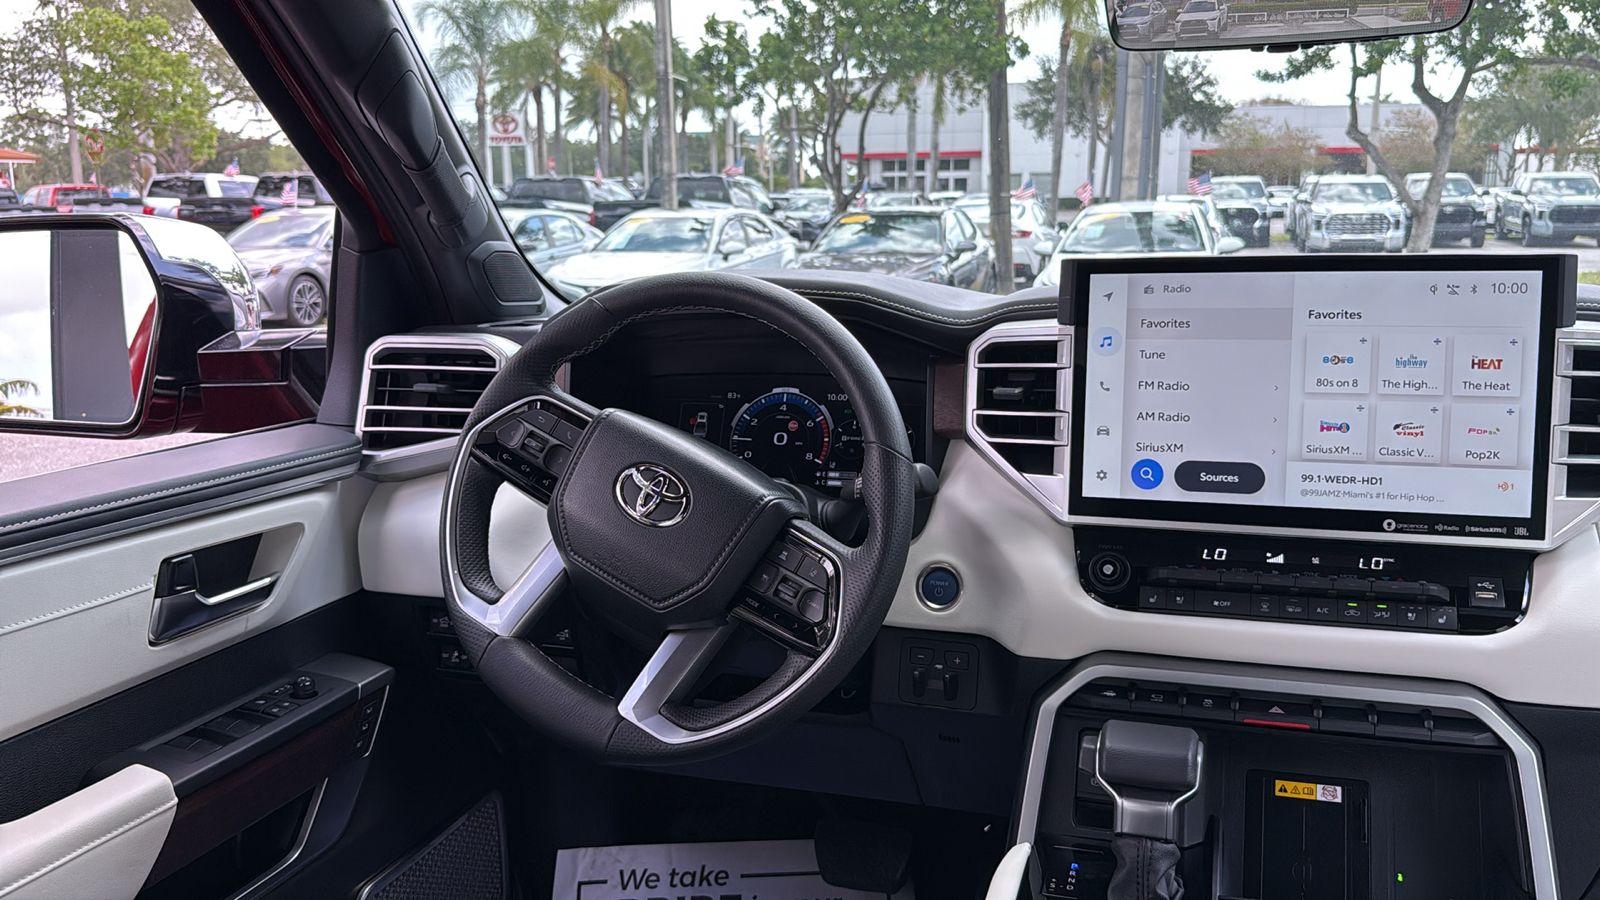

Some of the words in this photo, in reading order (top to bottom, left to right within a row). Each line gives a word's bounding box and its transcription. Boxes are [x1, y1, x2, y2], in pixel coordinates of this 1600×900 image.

[489, 136, 524, 144] TOYOTA
[1163, 284, 1191, 293] Radio
[1491, 282, 1528, 294] 10:00
[1308, 309, 1362, 320] Favorites
[1141, 318, 1190, 329] Favorites
[1139, 350, 1166, 360] Tune
[1395, 357, 1428, 369] highway
[1471, 359, 1504, 370] HEAT
[1138, 381, 1155, 390] FM
[1157, 381, 1190, 391] Radio
[1316, 378, 1334, 388] 80s
[1336, 380, 1350, 388] on
[1352, 378, 1359, 388] 8
[1382, 380, 1401, 389] The
[1403, 380, 1438, 391] High...
[1462, 381, 1482, 390] The
[1484, 382, 1511, 391] Heat
[827, 393, 848, 401] 10:00
[750, 418, 758, 426] 2
[1136, 412, 1155, 422] AM
[1158, 412, 1190, 423] Radio
[773, 432, 788, 445] 0
[1135, 442, 1184, 453] SiriusXM
[1306, 444, 1350, 455] SiriusXM
[1379, 447, 1415, 458] Classic
[744, 450, 752, 458] 0
[805, 452, 813, 460] 8
[1465, 450, 1501, 461] Pop2K
[1200, 472, 1239, 483] Sources
[1375, 491, 1385, 499] #1
[1386, 491, 1399, 500] for
[1400, 493, 1415, 502] Hip
[1416, 494, 1435, 503] Hop
[1514, 527, 1529, 536] JBL
[1202, 548, 1227, 561] LO
[1358, 557, 1384, 570] LO
[619, 868, 661, 891] We
[669, 864, 730, 888] take
